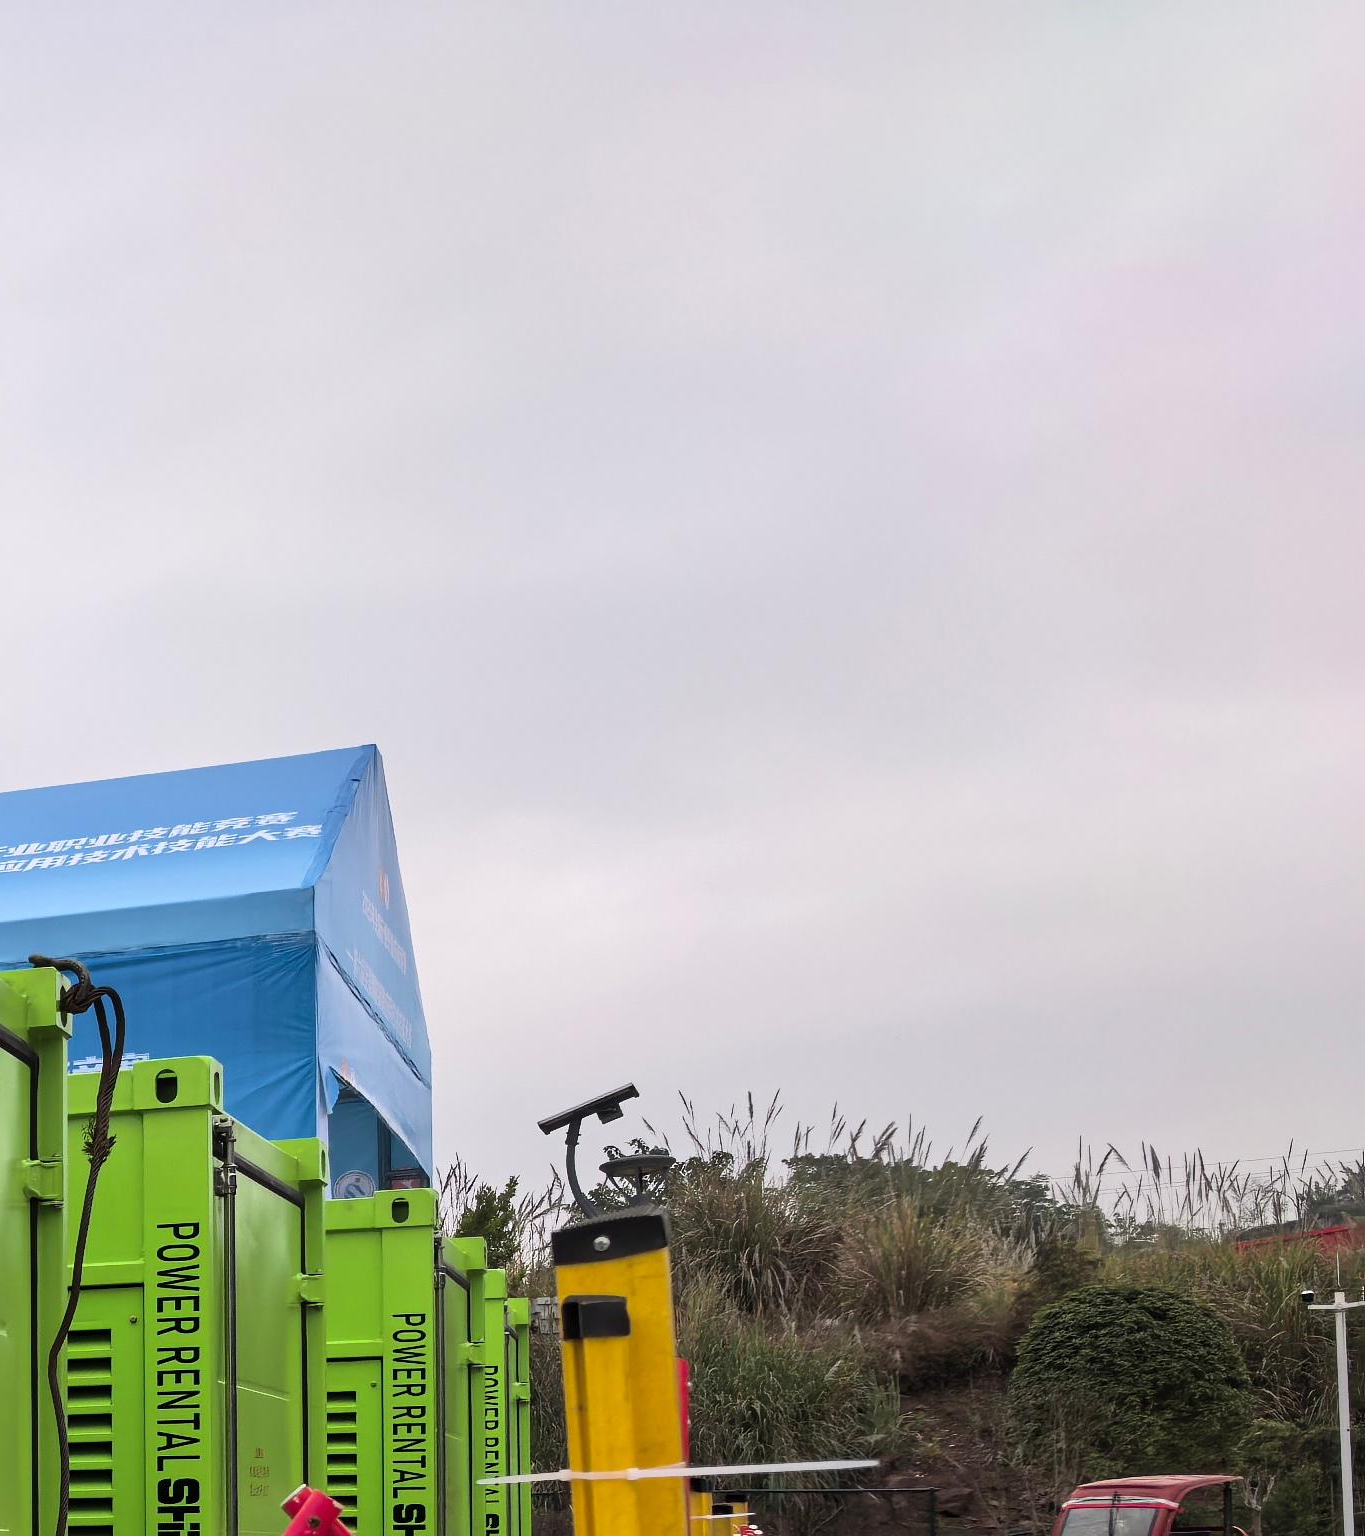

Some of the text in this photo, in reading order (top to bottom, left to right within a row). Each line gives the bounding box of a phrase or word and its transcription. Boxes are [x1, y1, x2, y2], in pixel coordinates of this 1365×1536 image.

[157, 1222, 200, 1336] POWER
[392, 1313, 427, 1398] POWER
[157, 1346, 200, 1472] RENTAL
[392, 1406, 427, 1499] RENTAL
